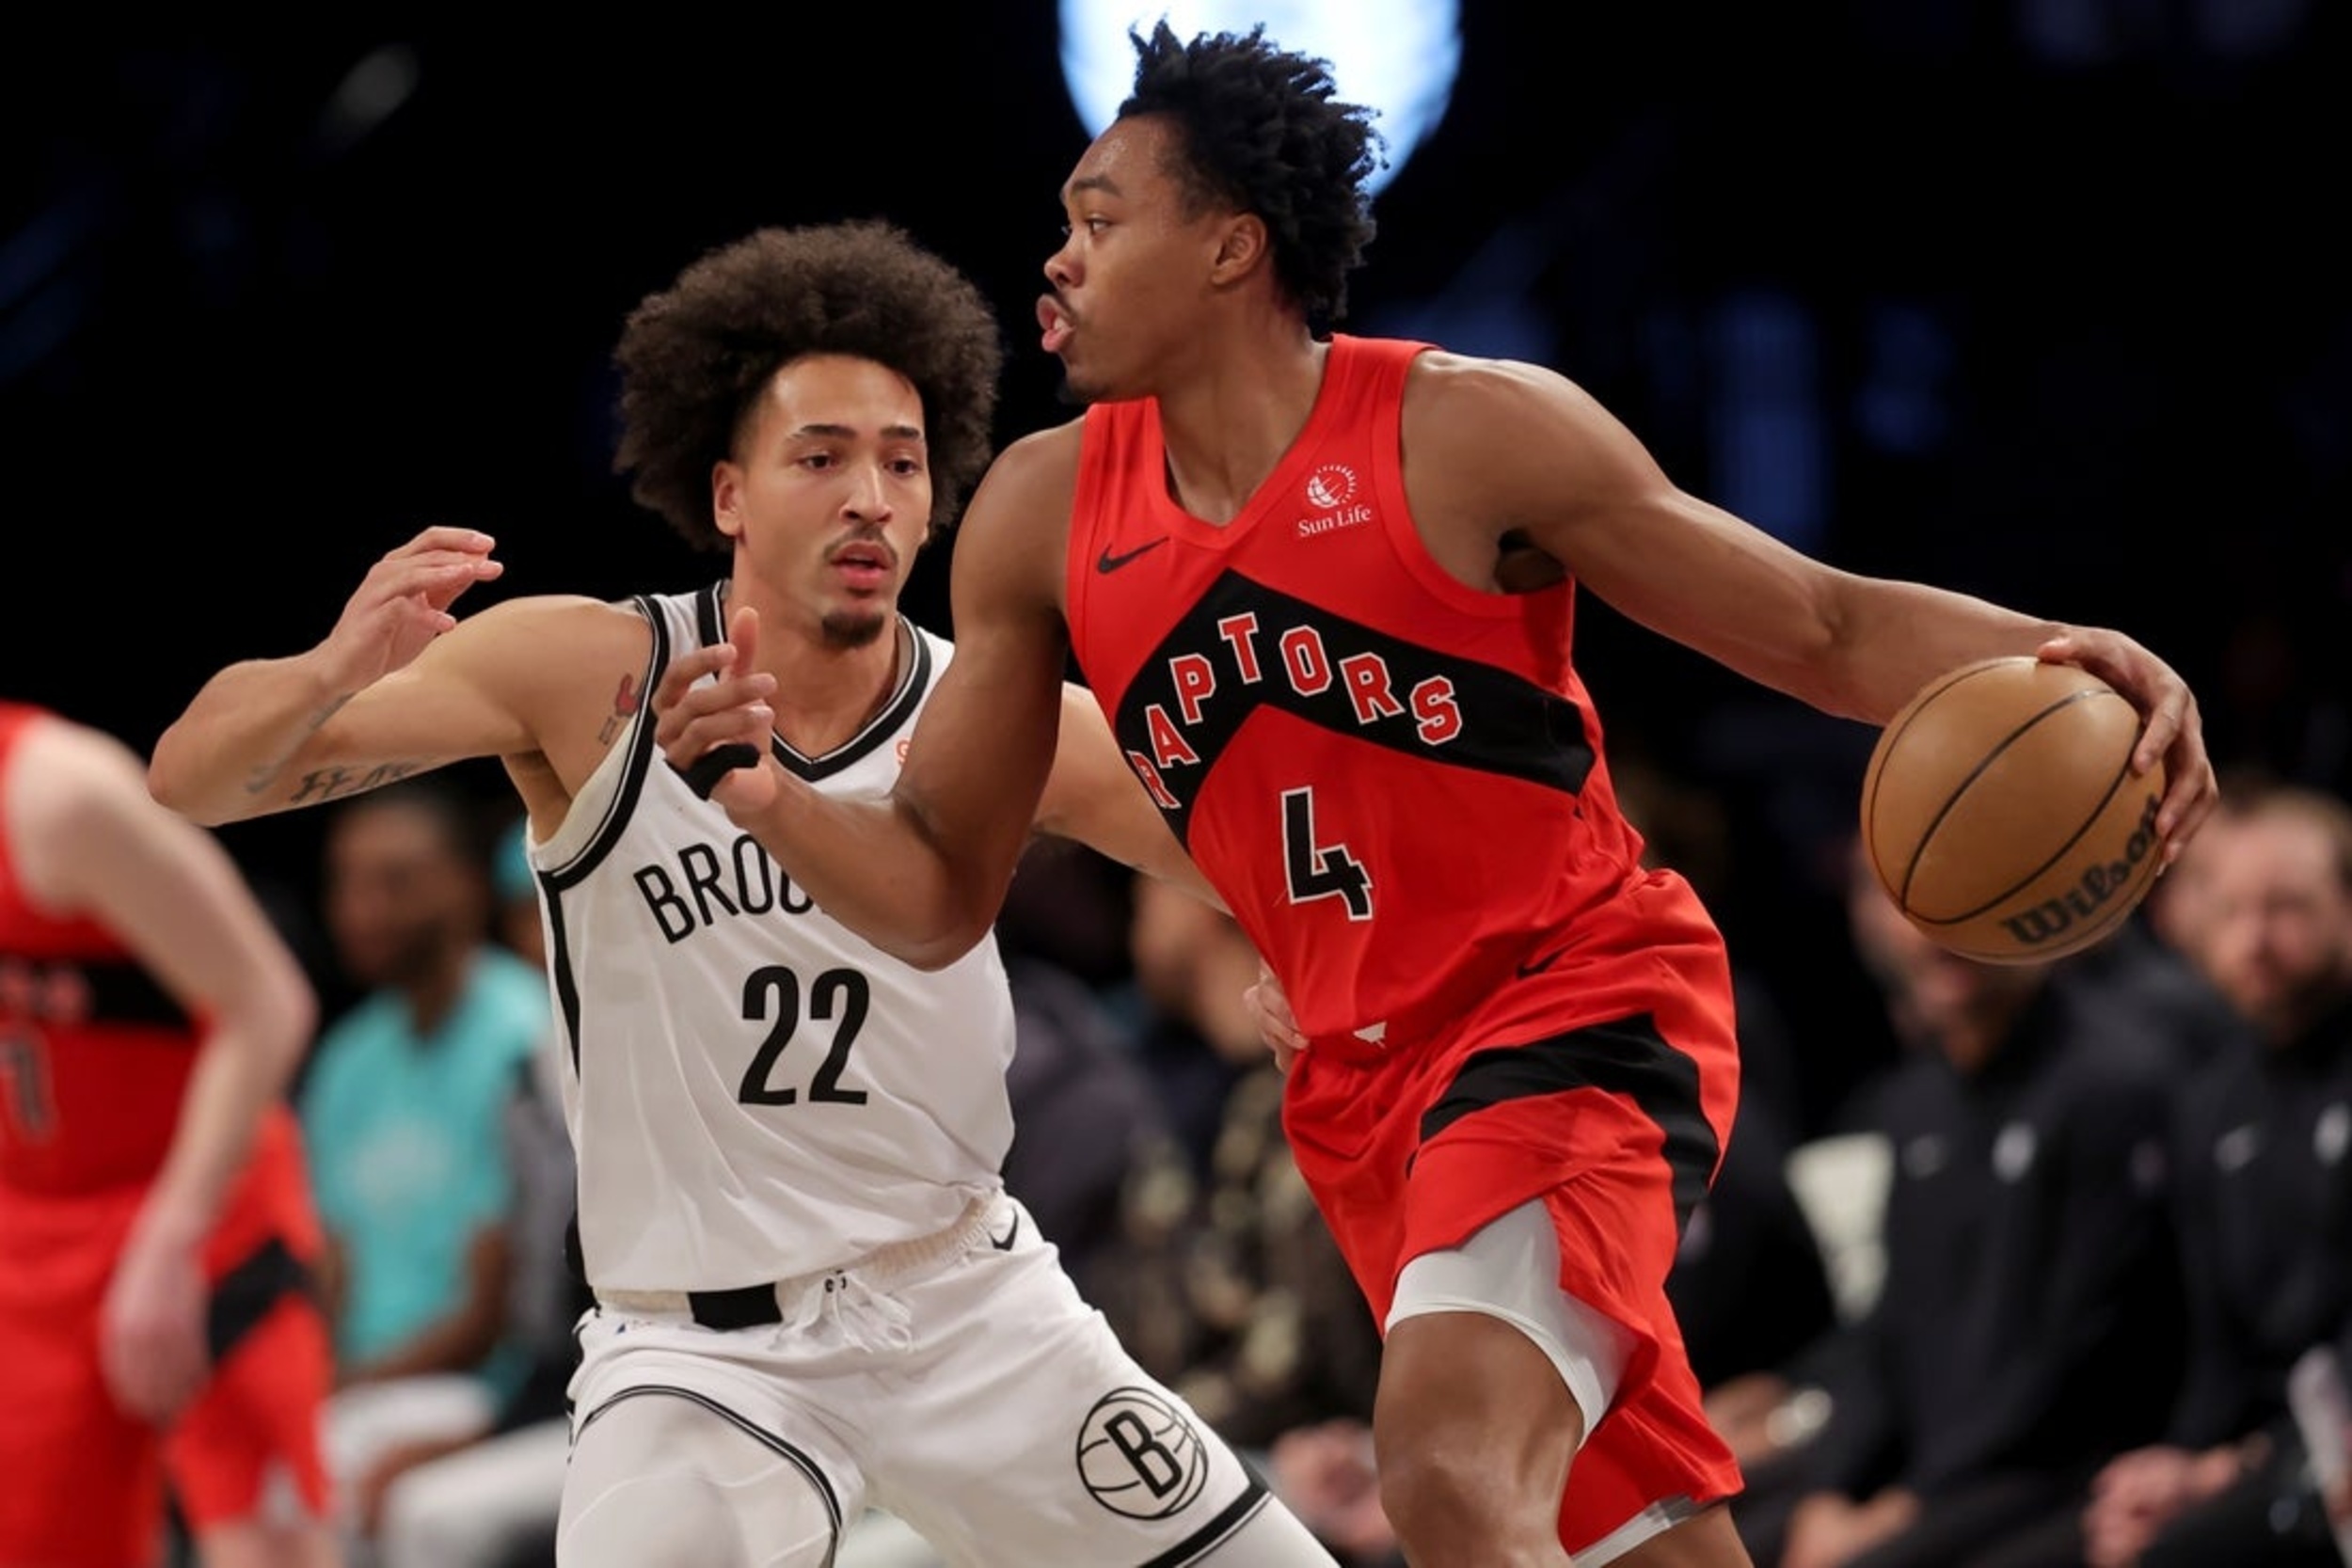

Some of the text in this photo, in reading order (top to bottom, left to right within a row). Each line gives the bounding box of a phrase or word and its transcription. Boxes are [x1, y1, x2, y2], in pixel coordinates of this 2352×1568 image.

[1298, 504, 1371, 537] Sun Life
[1126, 611, 1463, 809] RAPTORS
[1280, 785, 1374, 921] 4
[738, 965, 870, 1105] 22
